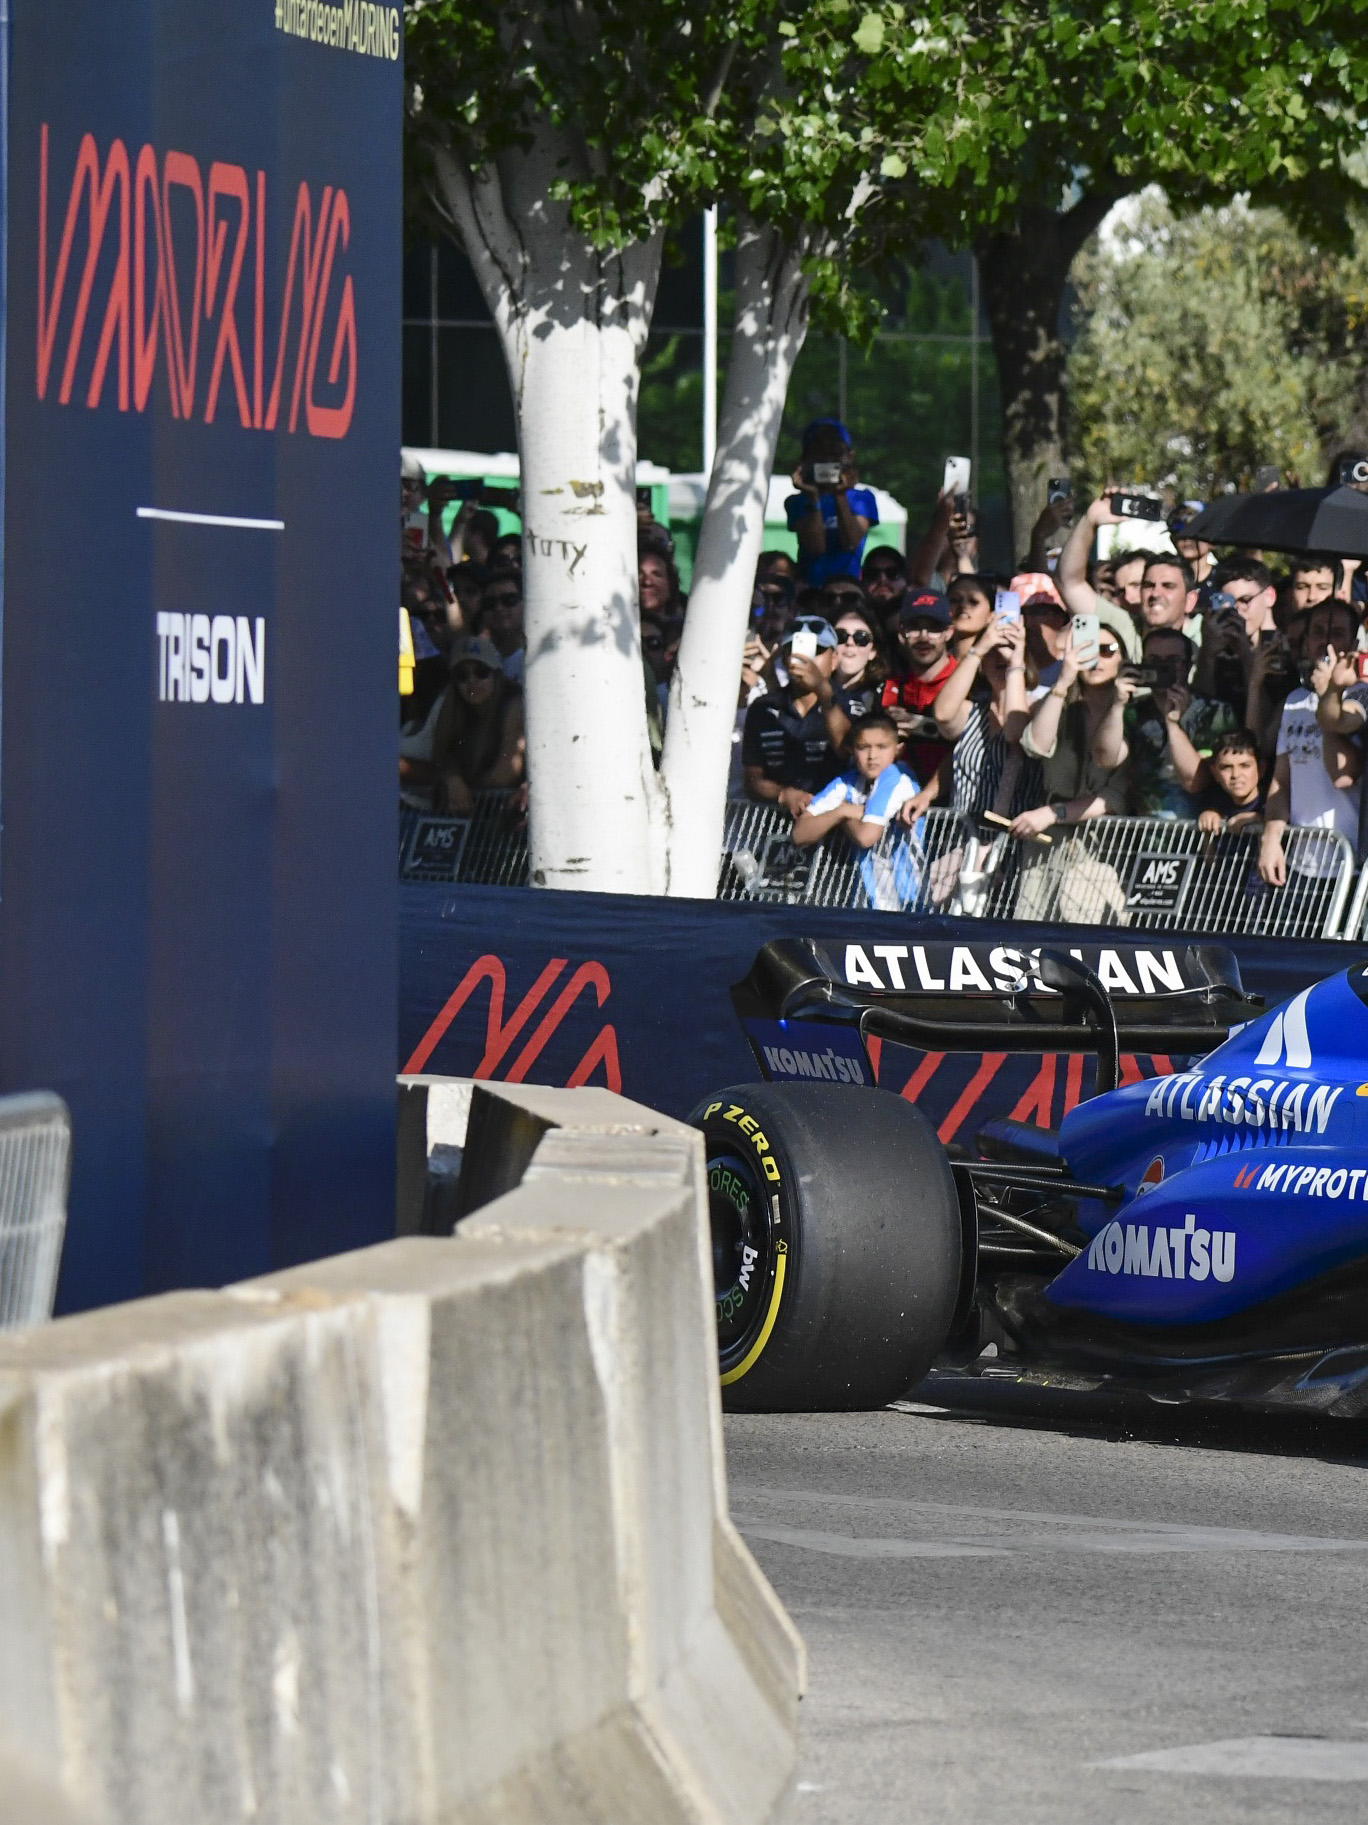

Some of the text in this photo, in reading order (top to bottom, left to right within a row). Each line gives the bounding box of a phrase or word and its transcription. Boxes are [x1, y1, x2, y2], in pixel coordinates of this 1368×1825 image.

[36, 122, 356, 439] MADRING
[157, 611, 265, 704] TRISON
[1142, 859, 1180, 884] AMS
[763, 1045, 865, 1085] KOMATSU
[1145, 1074, 1344, 1134] ATLASSIAN
[722, 1104, 781, 1182] ZERO
[1087, 1213, 1236, 1283] KOMATSU
